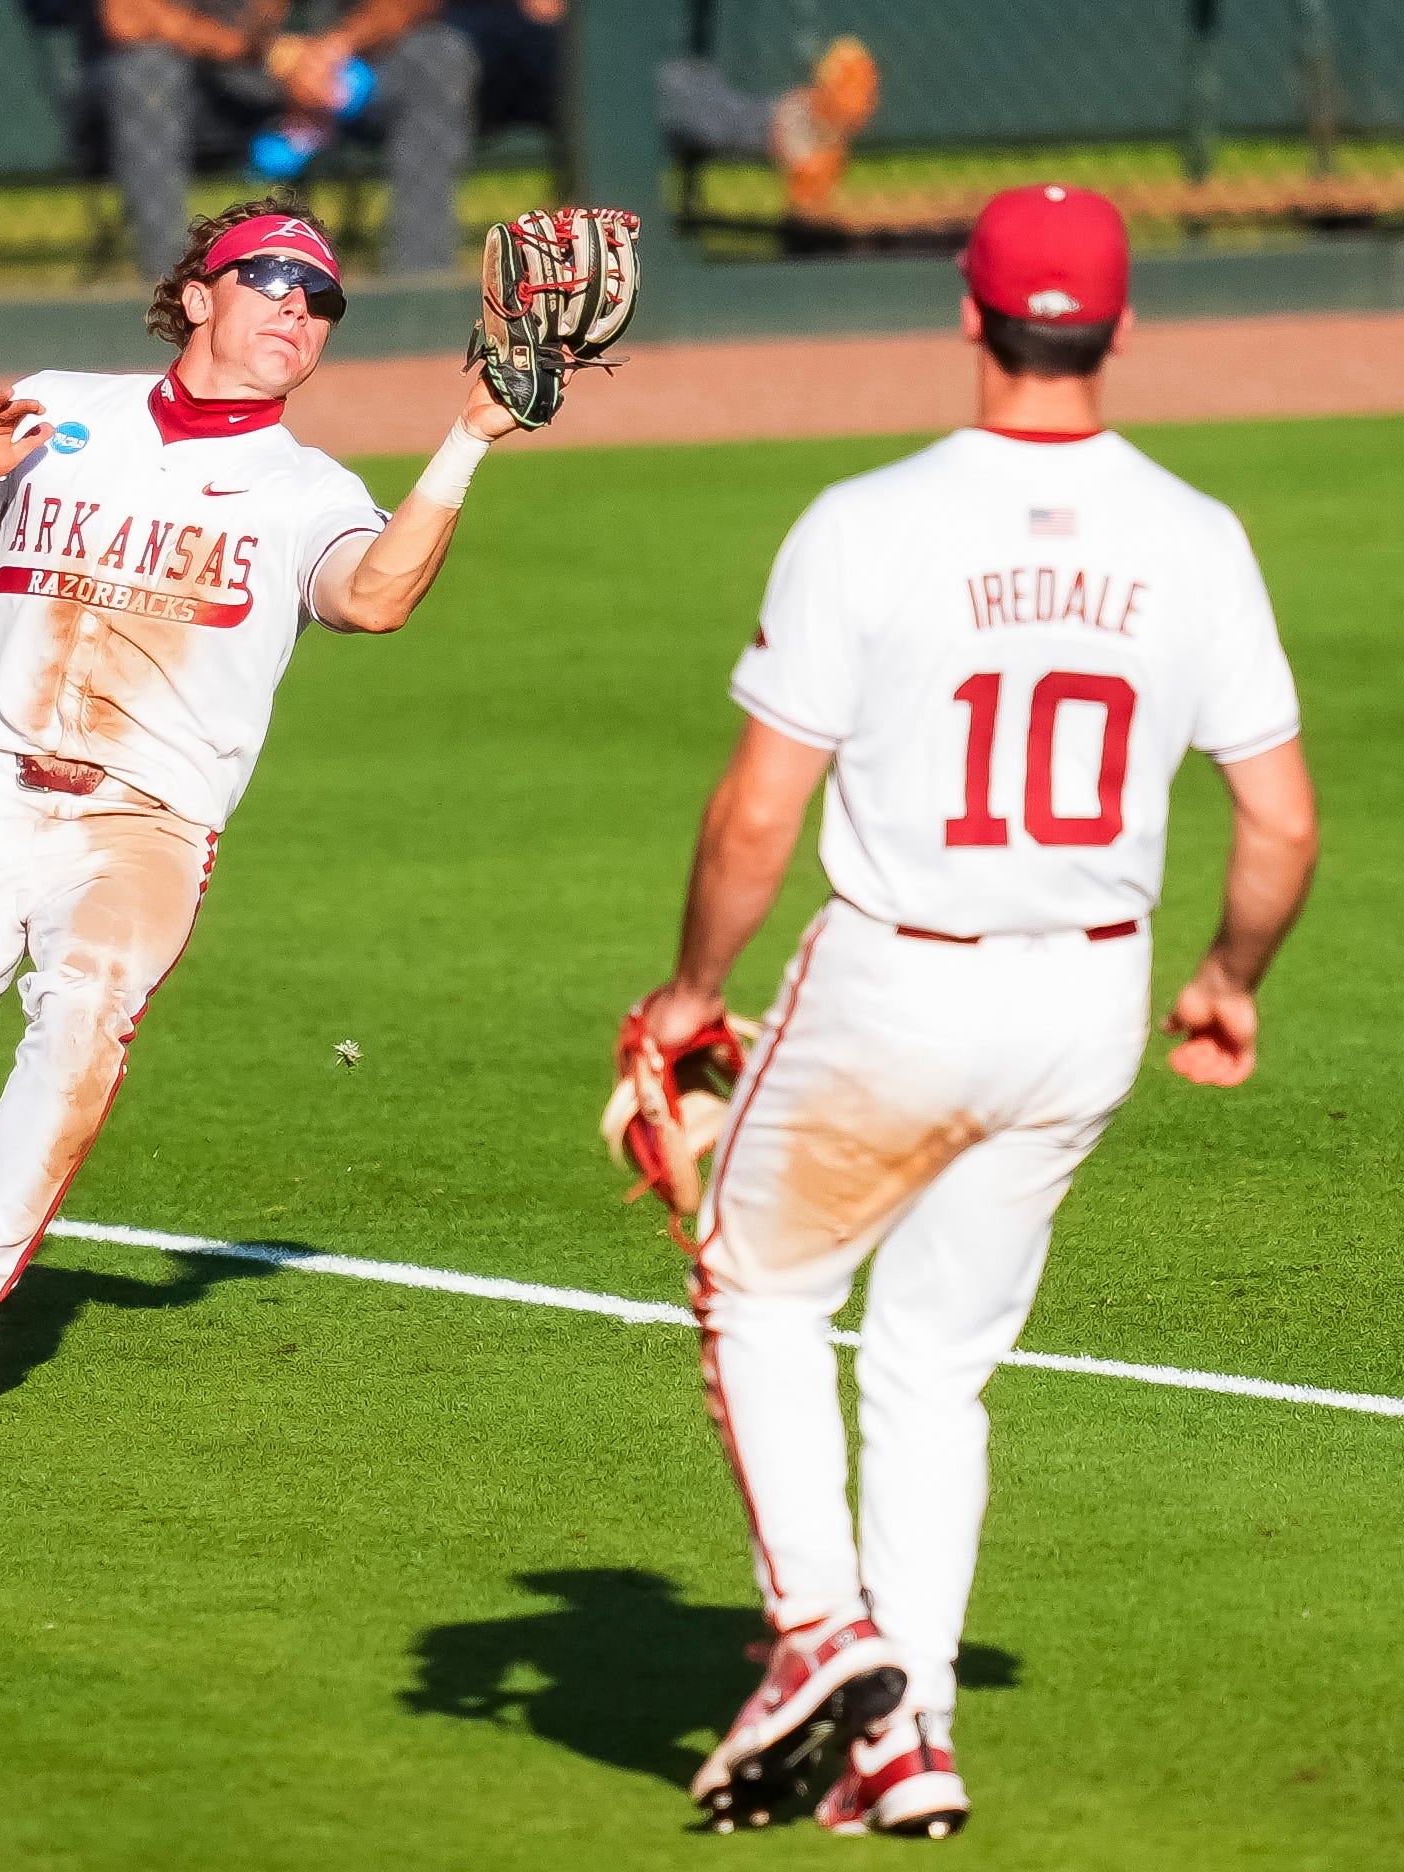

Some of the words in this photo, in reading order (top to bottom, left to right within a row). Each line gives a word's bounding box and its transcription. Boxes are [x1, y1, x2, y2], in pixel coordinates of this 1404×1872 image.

[9, 482, 258, 590] ARKANSAS
[28, 570, 197, 624] RAZORBACKS
[967, 567, 1147, 637] IREDALE
[945, 671, 1137, 846] 10
